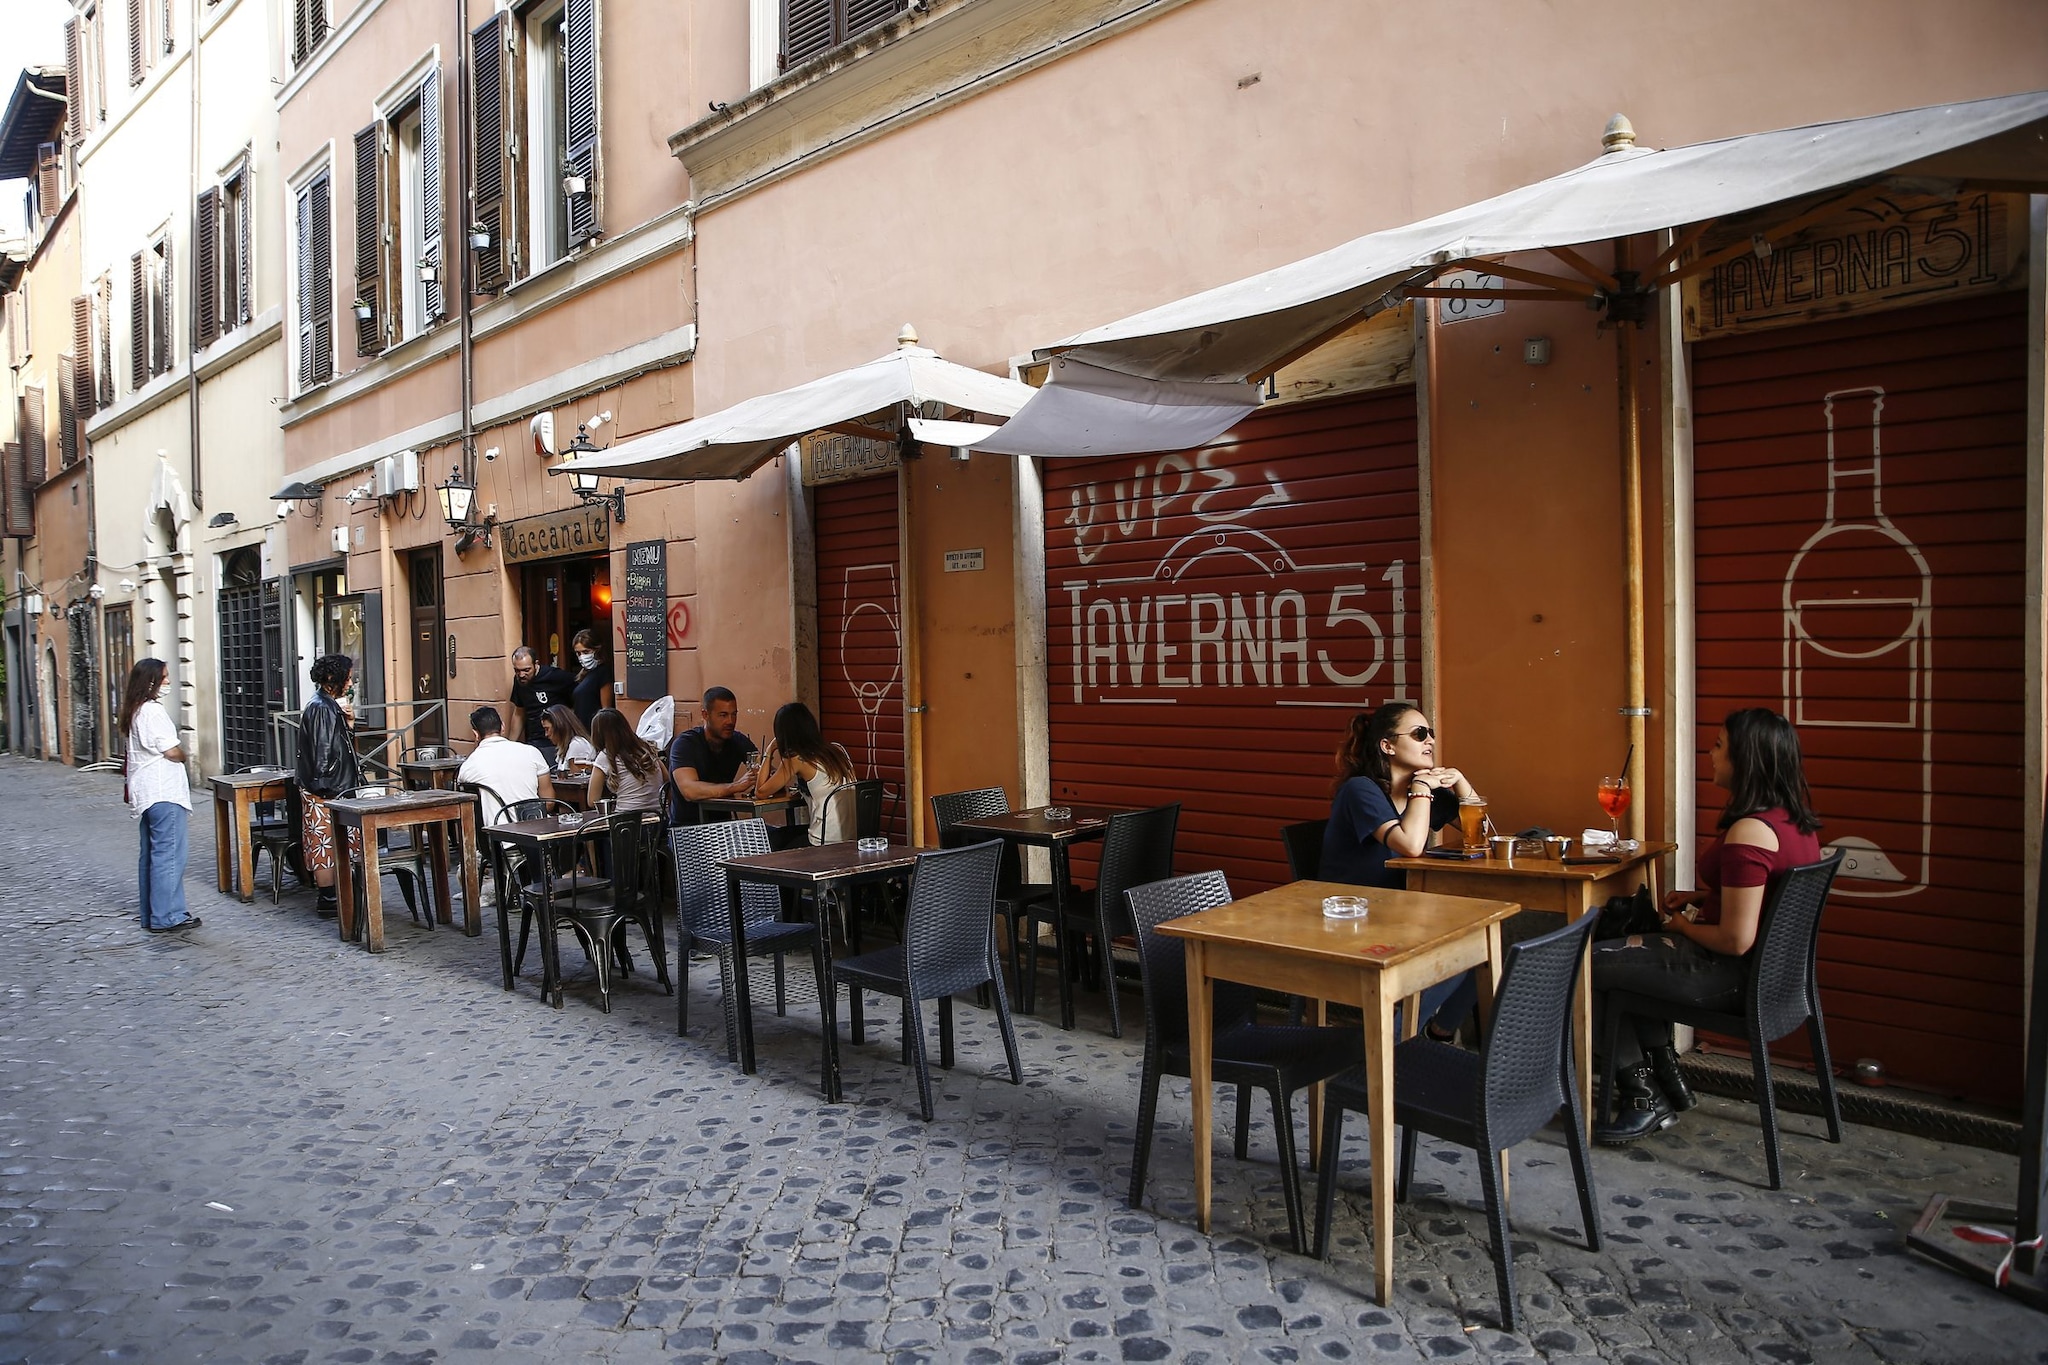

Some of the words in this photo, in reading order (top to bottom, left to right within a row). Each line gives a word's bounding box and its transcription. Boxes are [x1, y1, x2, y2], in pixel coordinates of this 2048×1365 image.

[1712, 225, 1911, 329] TAVERNA
[1917, 194, 1998, 286] 51
[1448, 273, 1496, 315] 83
[808, 433, 873, 481] TAVERNA
[502, 511, 607, 560] Baccanale
[632, 545, 661, 566] MENU
[1063, 579, 1310, 704] TAVERNA
[1317, 559, 1418, 706] 51
